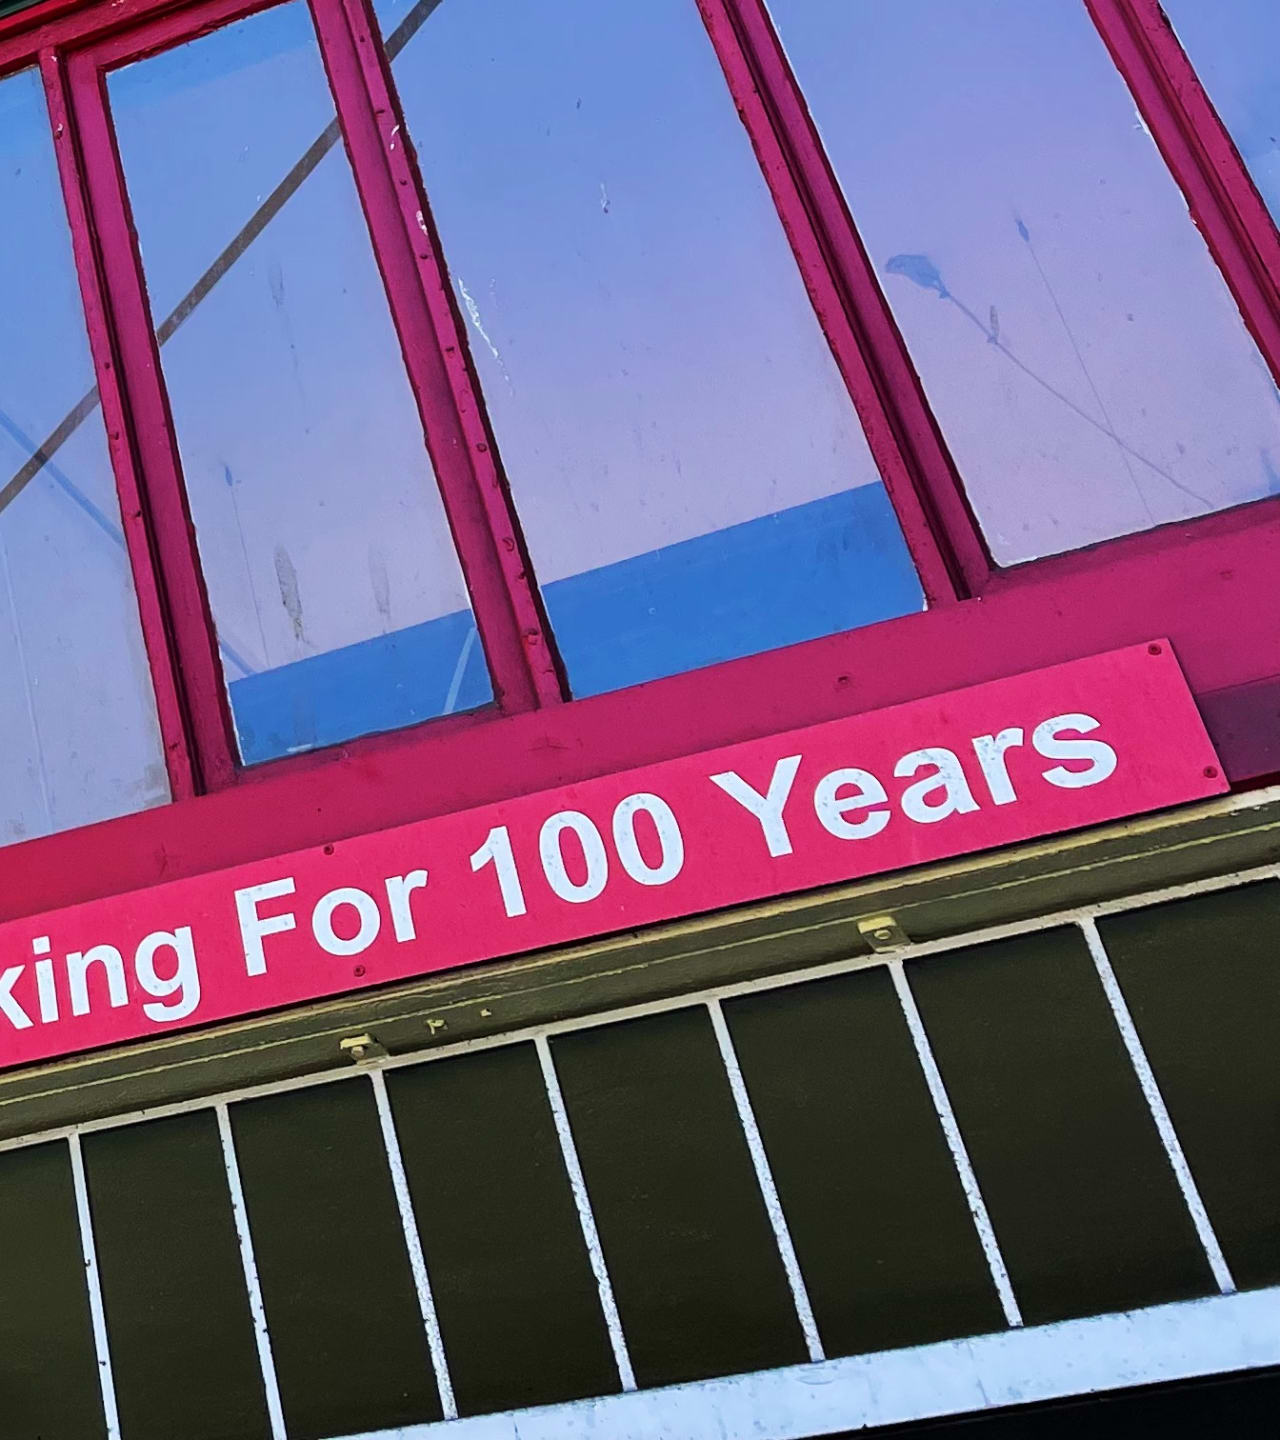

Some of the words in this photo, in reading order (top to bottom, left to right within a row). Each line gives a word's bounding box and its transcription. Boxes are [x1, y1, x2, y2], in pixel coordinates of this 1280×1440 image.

[232, 867, 431, 979] For
[467, 791, 687, 920] 100
[707, 711, 1121, 860] Years
